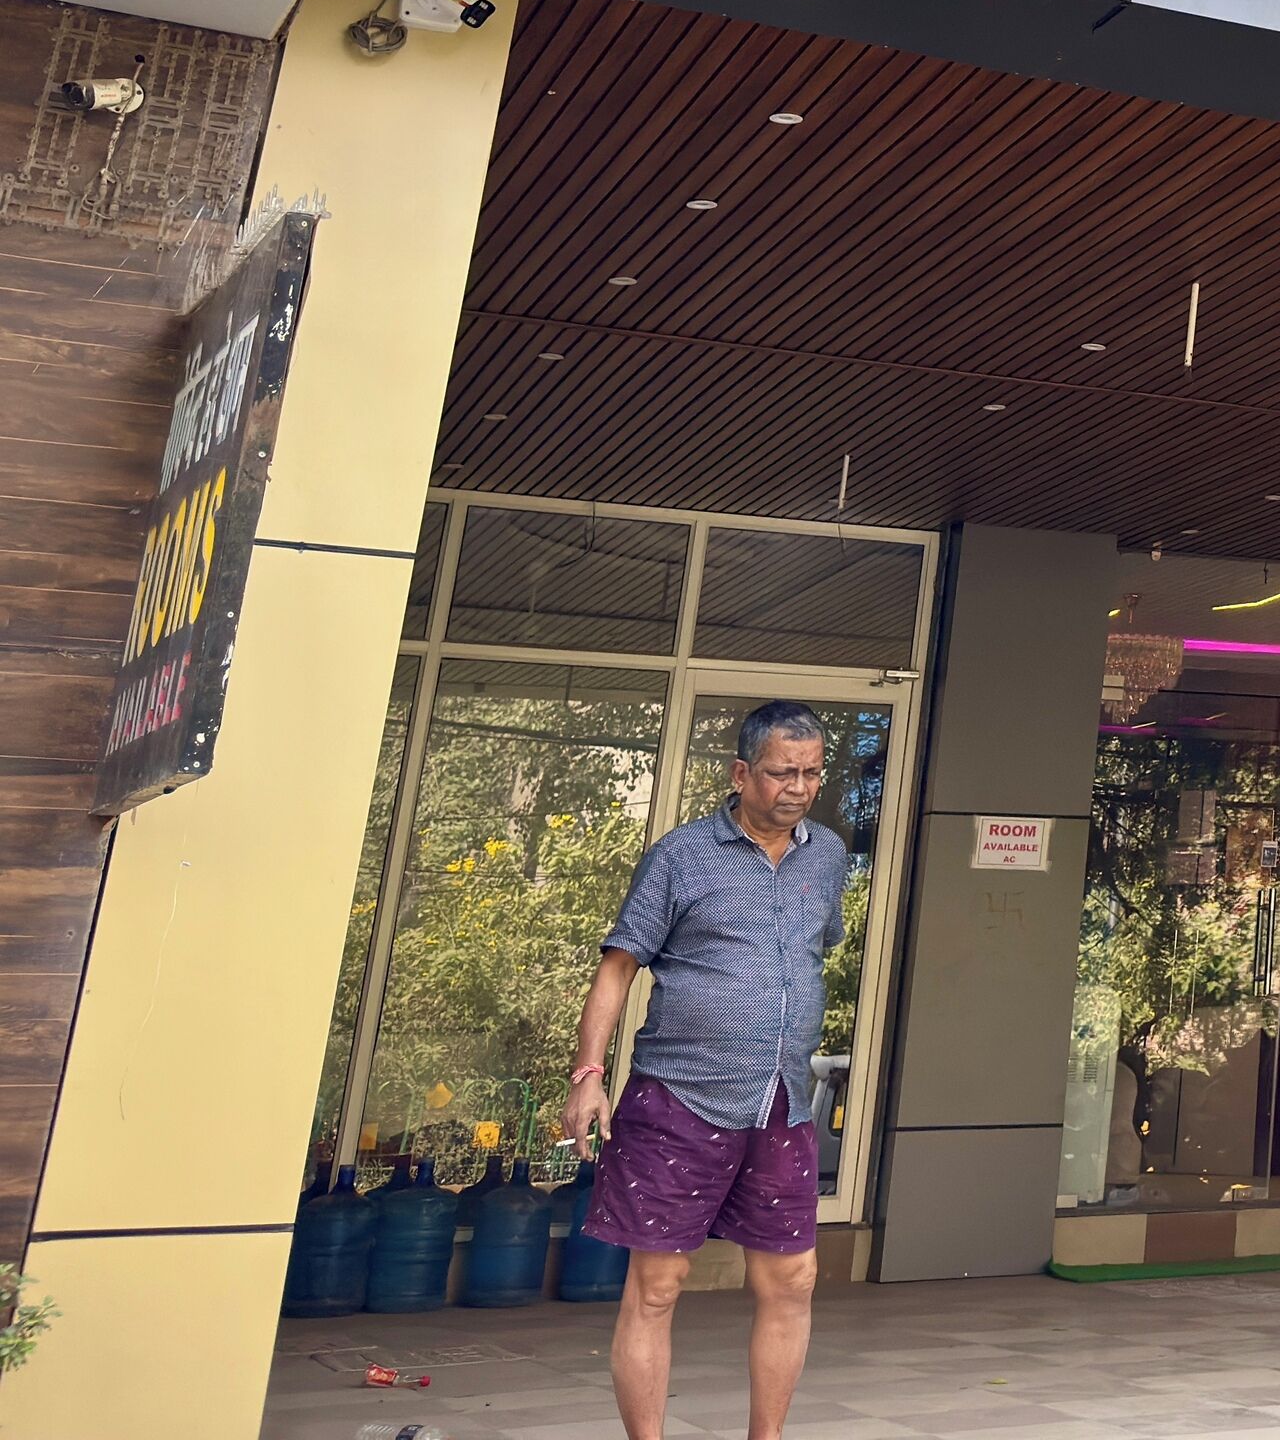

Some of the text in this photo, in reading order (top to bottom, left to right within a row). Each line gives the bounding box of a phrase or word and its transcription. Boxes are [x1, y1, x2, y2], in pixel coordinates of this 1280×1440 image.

[120, 464, 228, 667] ROOMS
[104, 652, 192, 758] AVAILABLE
[989, 824, 1037, 837] ROOM
[983, 842, 1038, 852] AVAILABLE
[1003, 855, 1016, 863] AC
